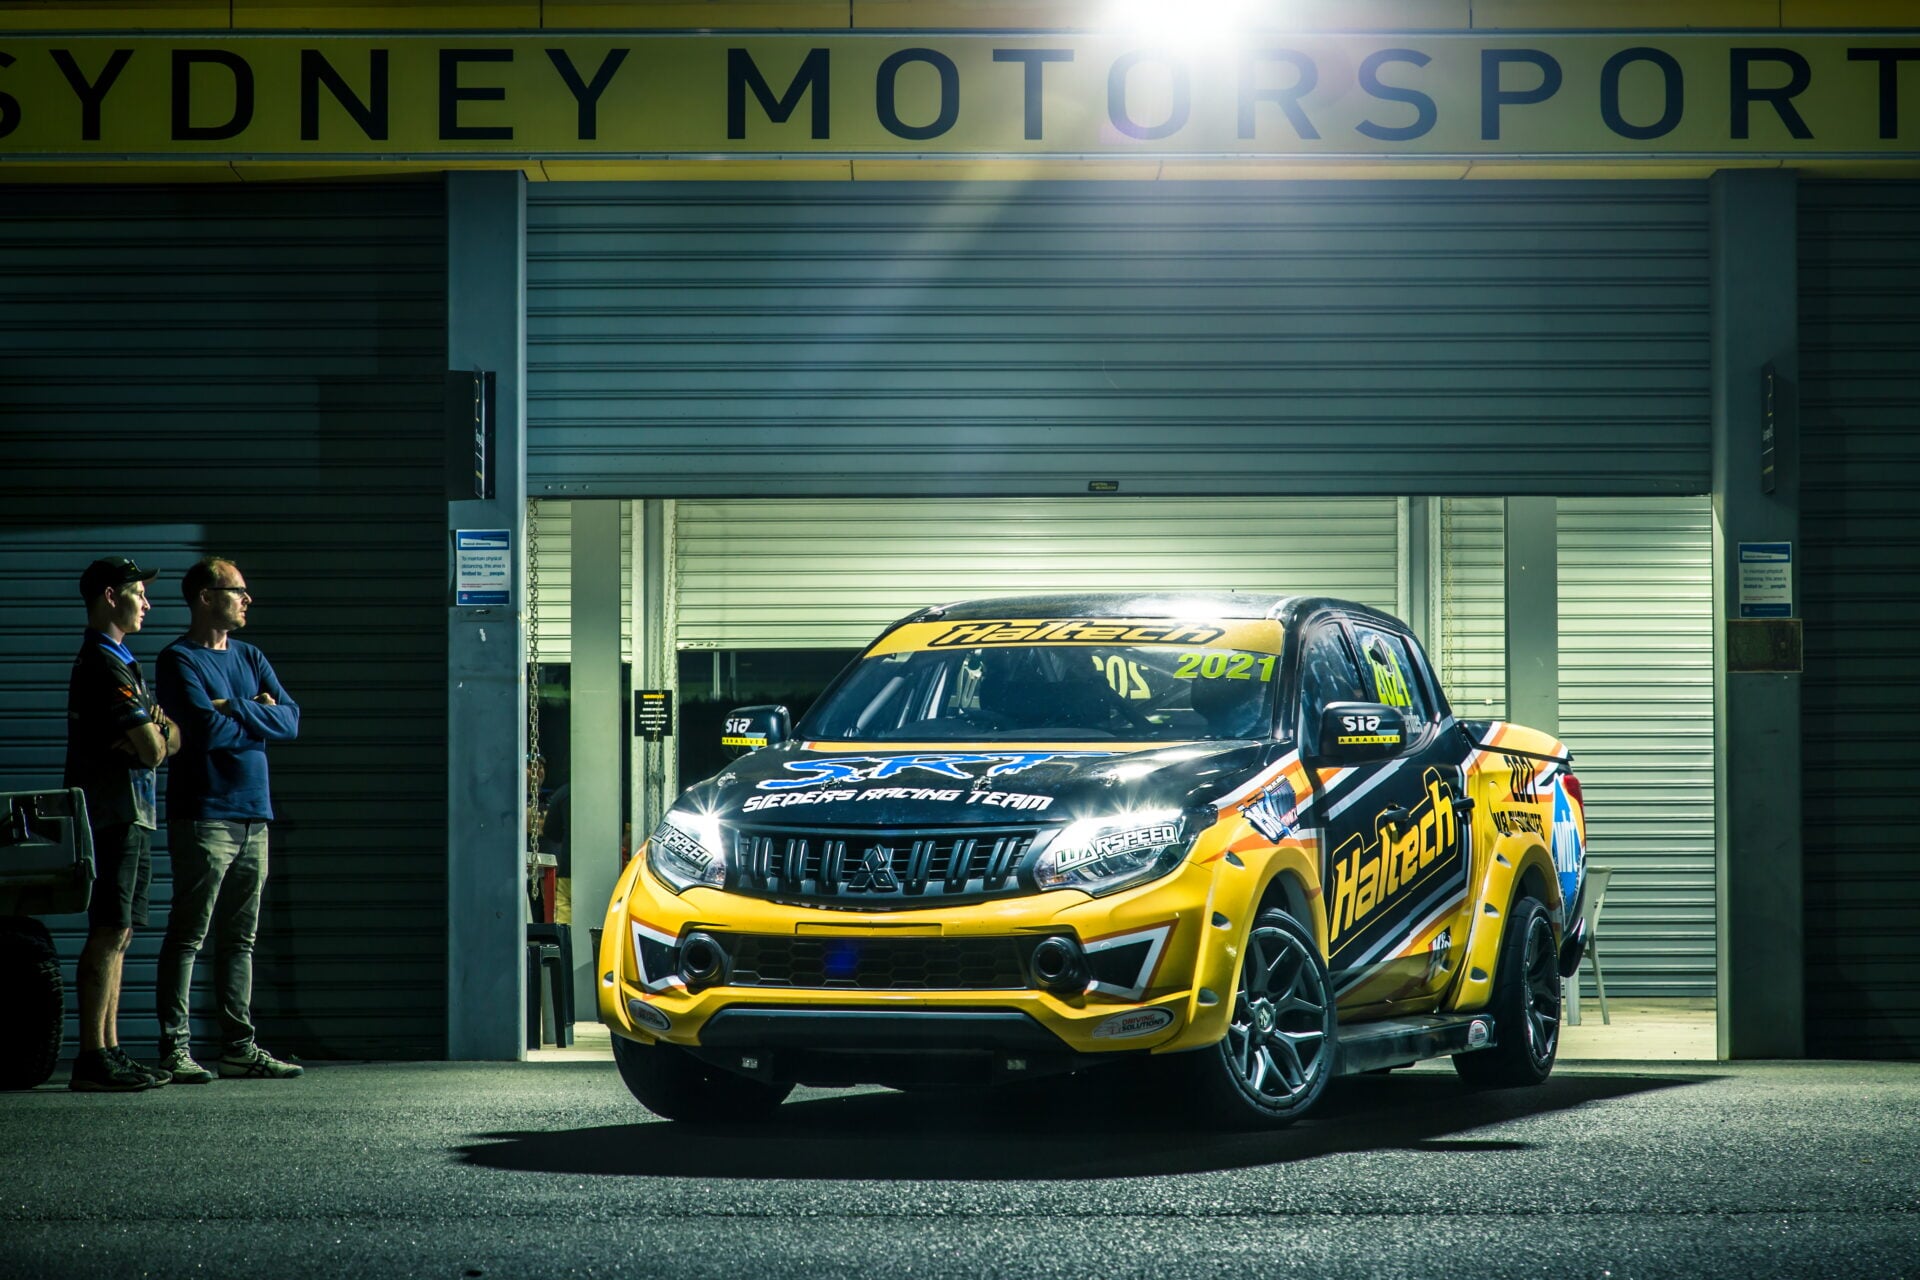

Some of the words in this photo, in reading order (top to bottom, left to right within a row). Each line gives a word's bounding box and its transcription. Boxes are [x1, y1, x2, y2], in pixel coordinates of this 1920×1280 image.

[0, 47, 631, 142] YDNEY
[727, 46, 1920, 142] MOTORSPORT
[929, 620, 1223, 647] Haltech
[1172, 653, 1276, 682] 2021
[725, 718, 752, 734] sia
[1342, 715, 1381, 732] sia
[1339, 736, 1399, 744] ABRASIVES
[1503, 755, 1539, 804] 2021
[742, 789, 858, 813] SIEDERS
[855, 787, 965, 802] RACING
[965, 790, 1055, 811] TEAM
[1056, 825, 1177, 868] WARSPEED
[1330, 780, 1456, 943] Haltech
[1121, 1014, 1156, 1025] DRIVING
[1121, 1017, 1165, 1032] SOLUTIONS
